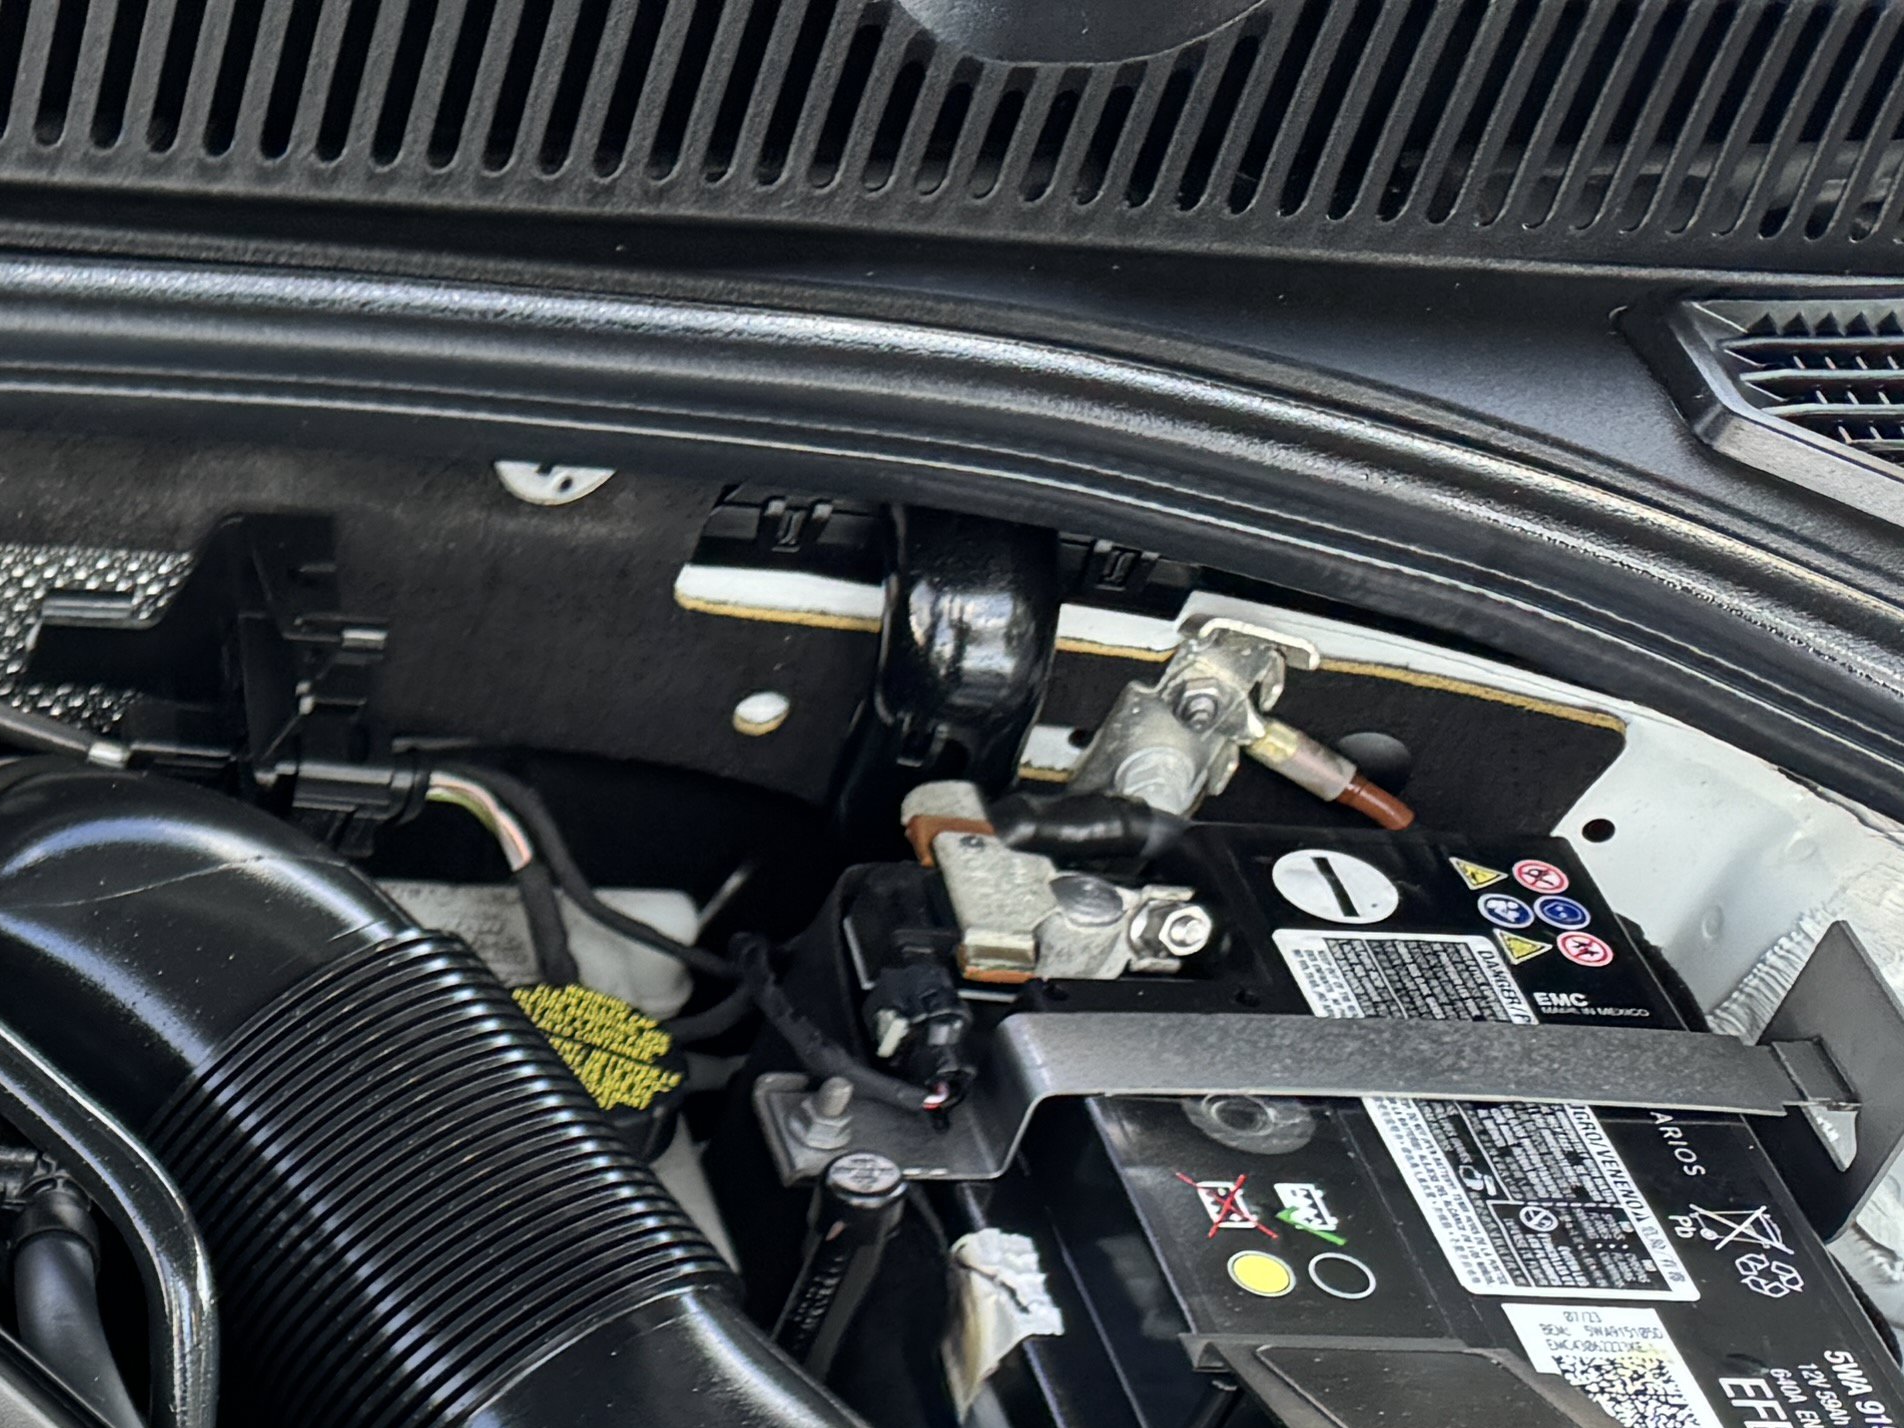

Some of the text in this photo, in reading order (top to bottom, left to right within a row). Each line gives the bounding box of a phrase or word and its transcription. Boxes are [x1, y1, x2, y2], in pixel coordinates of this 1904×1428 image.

[1533, 992, 1589, 1007] EMC
[1650, 1111, 1706, 1176] ARIOS
[1668, 1215, 1696, 1239] Pb
[1798, 1363, 1832, 1388] 12V
[1824, 1350, 1873, 1396] 5WA
